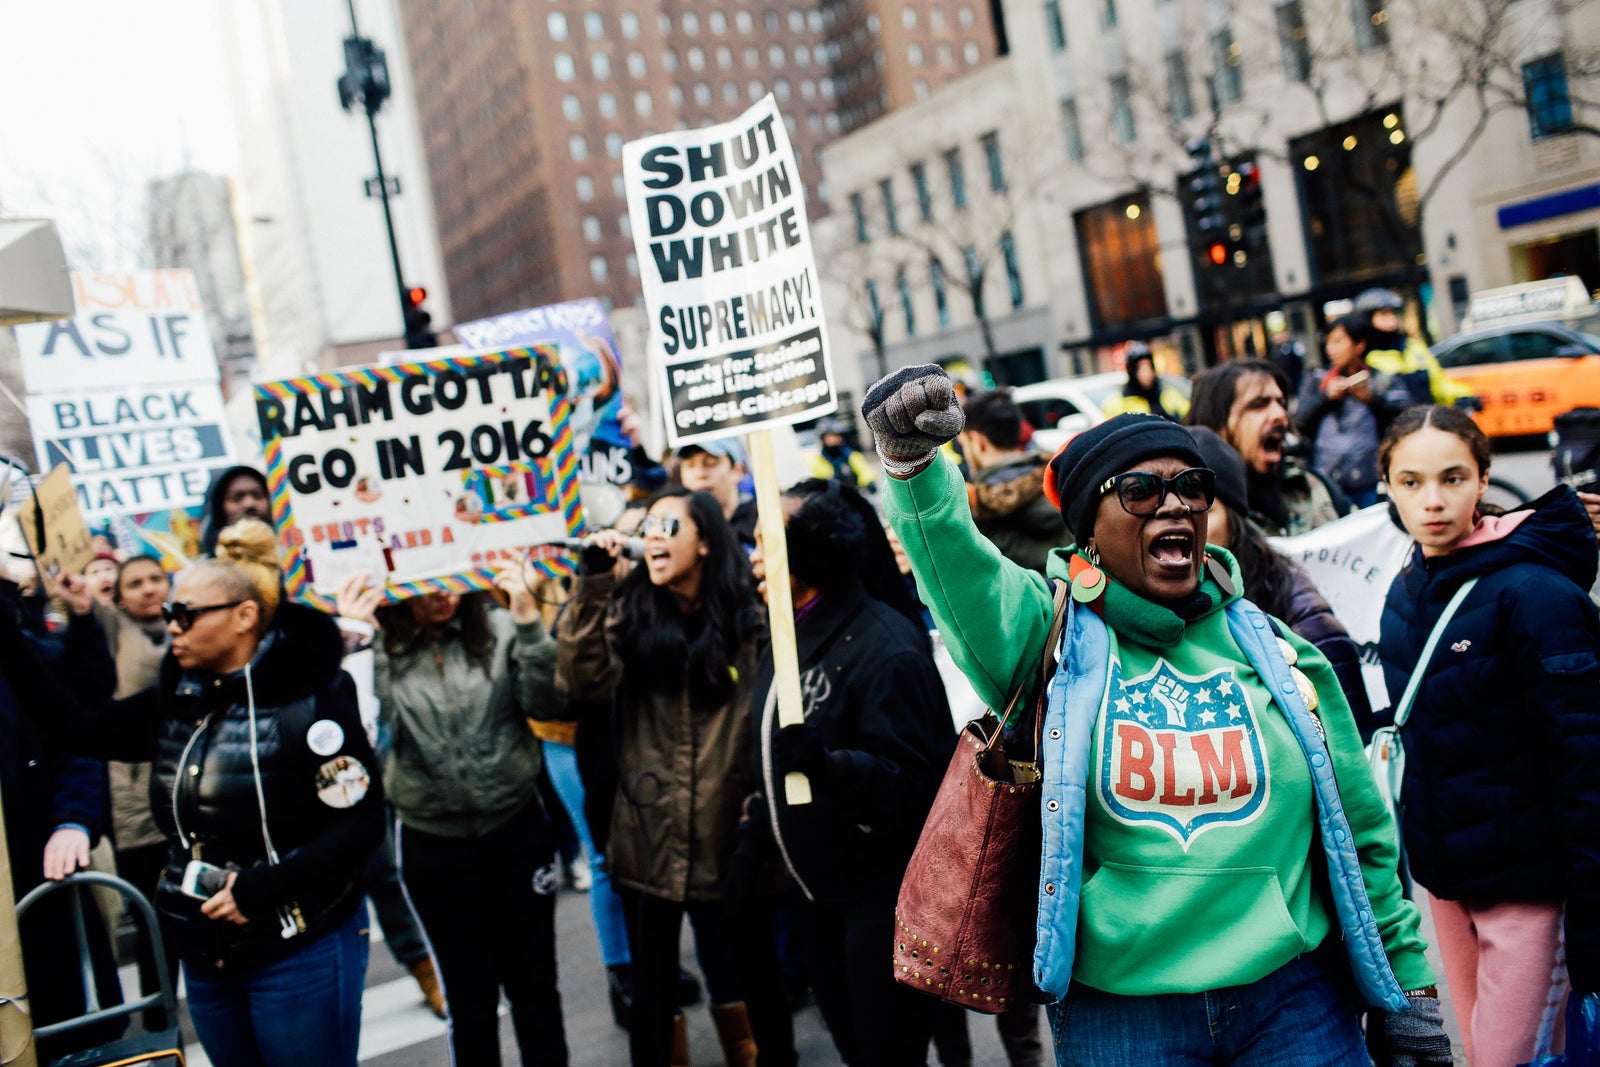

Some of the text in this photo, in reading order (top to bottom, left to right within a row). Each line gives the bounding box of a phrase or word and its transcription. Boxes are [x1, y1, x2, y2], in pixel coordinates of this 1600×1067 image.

[640, 113, 777, 189] SHUT
[645, 160, 792, 237] DOWN
[650, 207, 801, 284] WHITE
[659, 267, 815, 356] SUPREMACY!
[41, 314, 189, 359] AS IF
[672, 337, 821, 387] Party for Socialism
[688, 357, 816, 401] and Liberation
[54, 391, 198, 430] BLACK
[257, 354, 569, 440] RAHM GOTTA
[676, 379, 829, 428] @PSLChicago
[69, 426, 204, 474] LIVES
[288, 420, 553, 494] GO IN 2016
[576, 446, 632, 484] UNS
[75, 470, 207, 510] ATTE
[312, 517, 385, 543] SHOTS
[390, 526, 455, 551] AND A
[1303, 547, 1380, 584] POLICE
[1115, 724, 1252, 806] BLM
